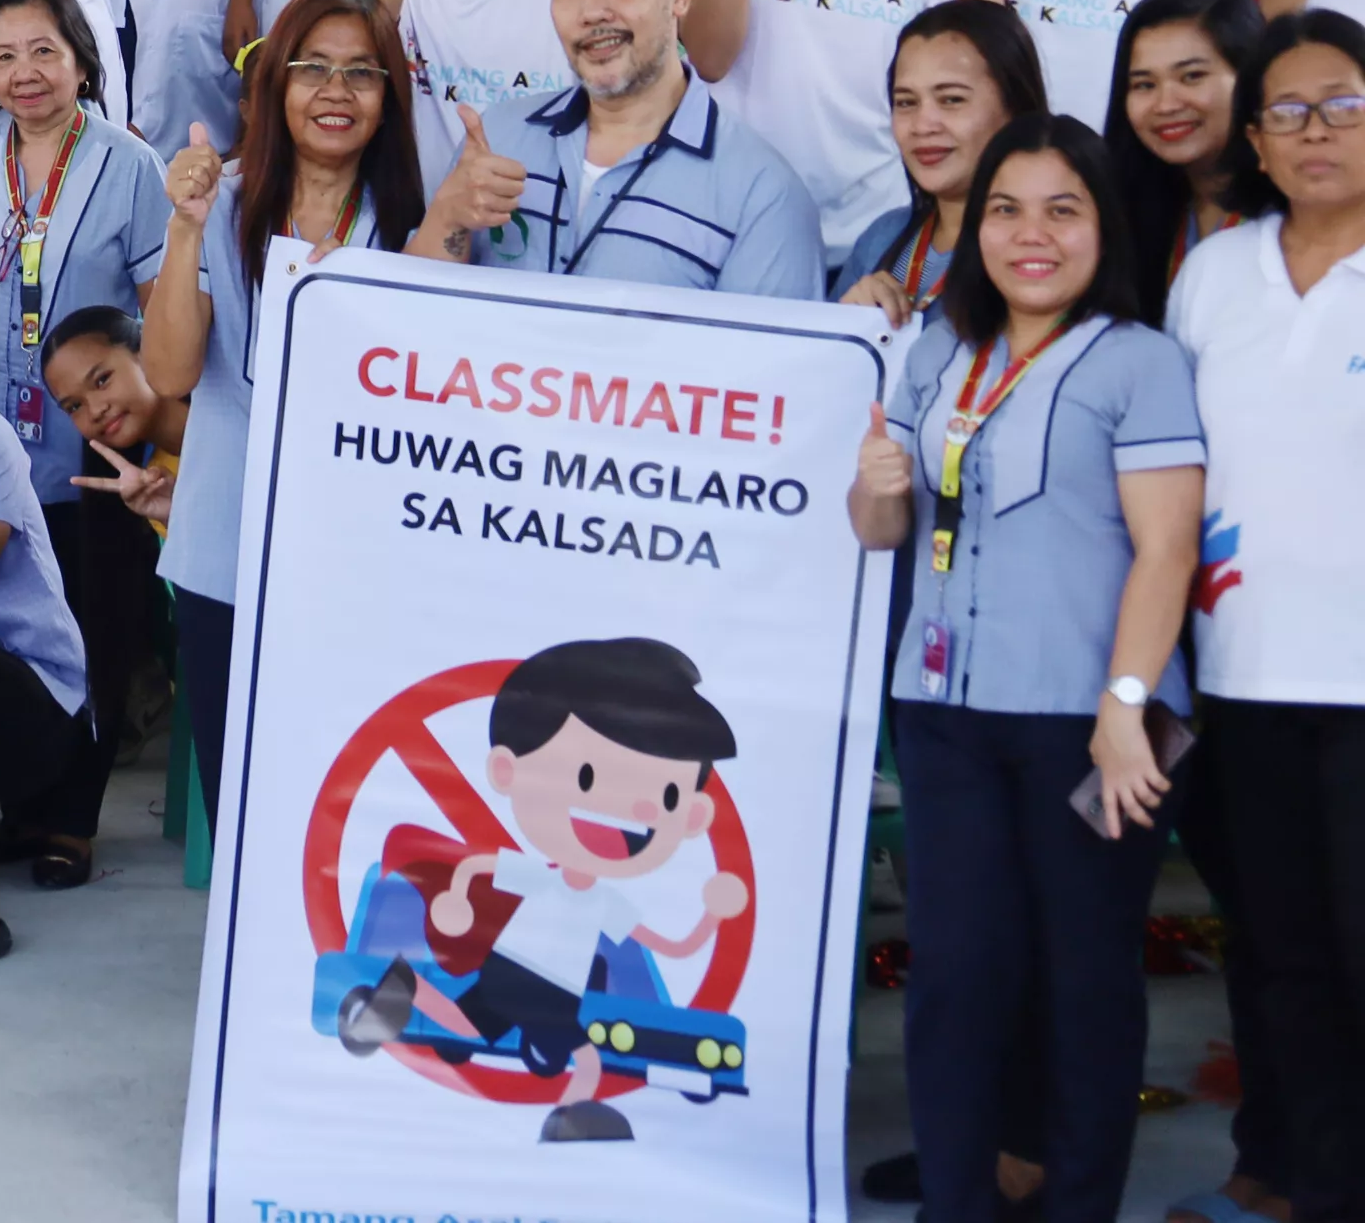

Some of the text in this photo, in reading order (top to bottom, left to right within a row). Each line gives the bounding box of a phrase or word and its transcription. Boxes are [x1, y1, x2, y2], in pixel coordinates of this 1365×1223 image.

[357, 346, 786, 446] CLASSMATE!
[333, 421, 810, 517] HUWAG MAGLARO
[400, 491, 722, 570] SA KALSADA
